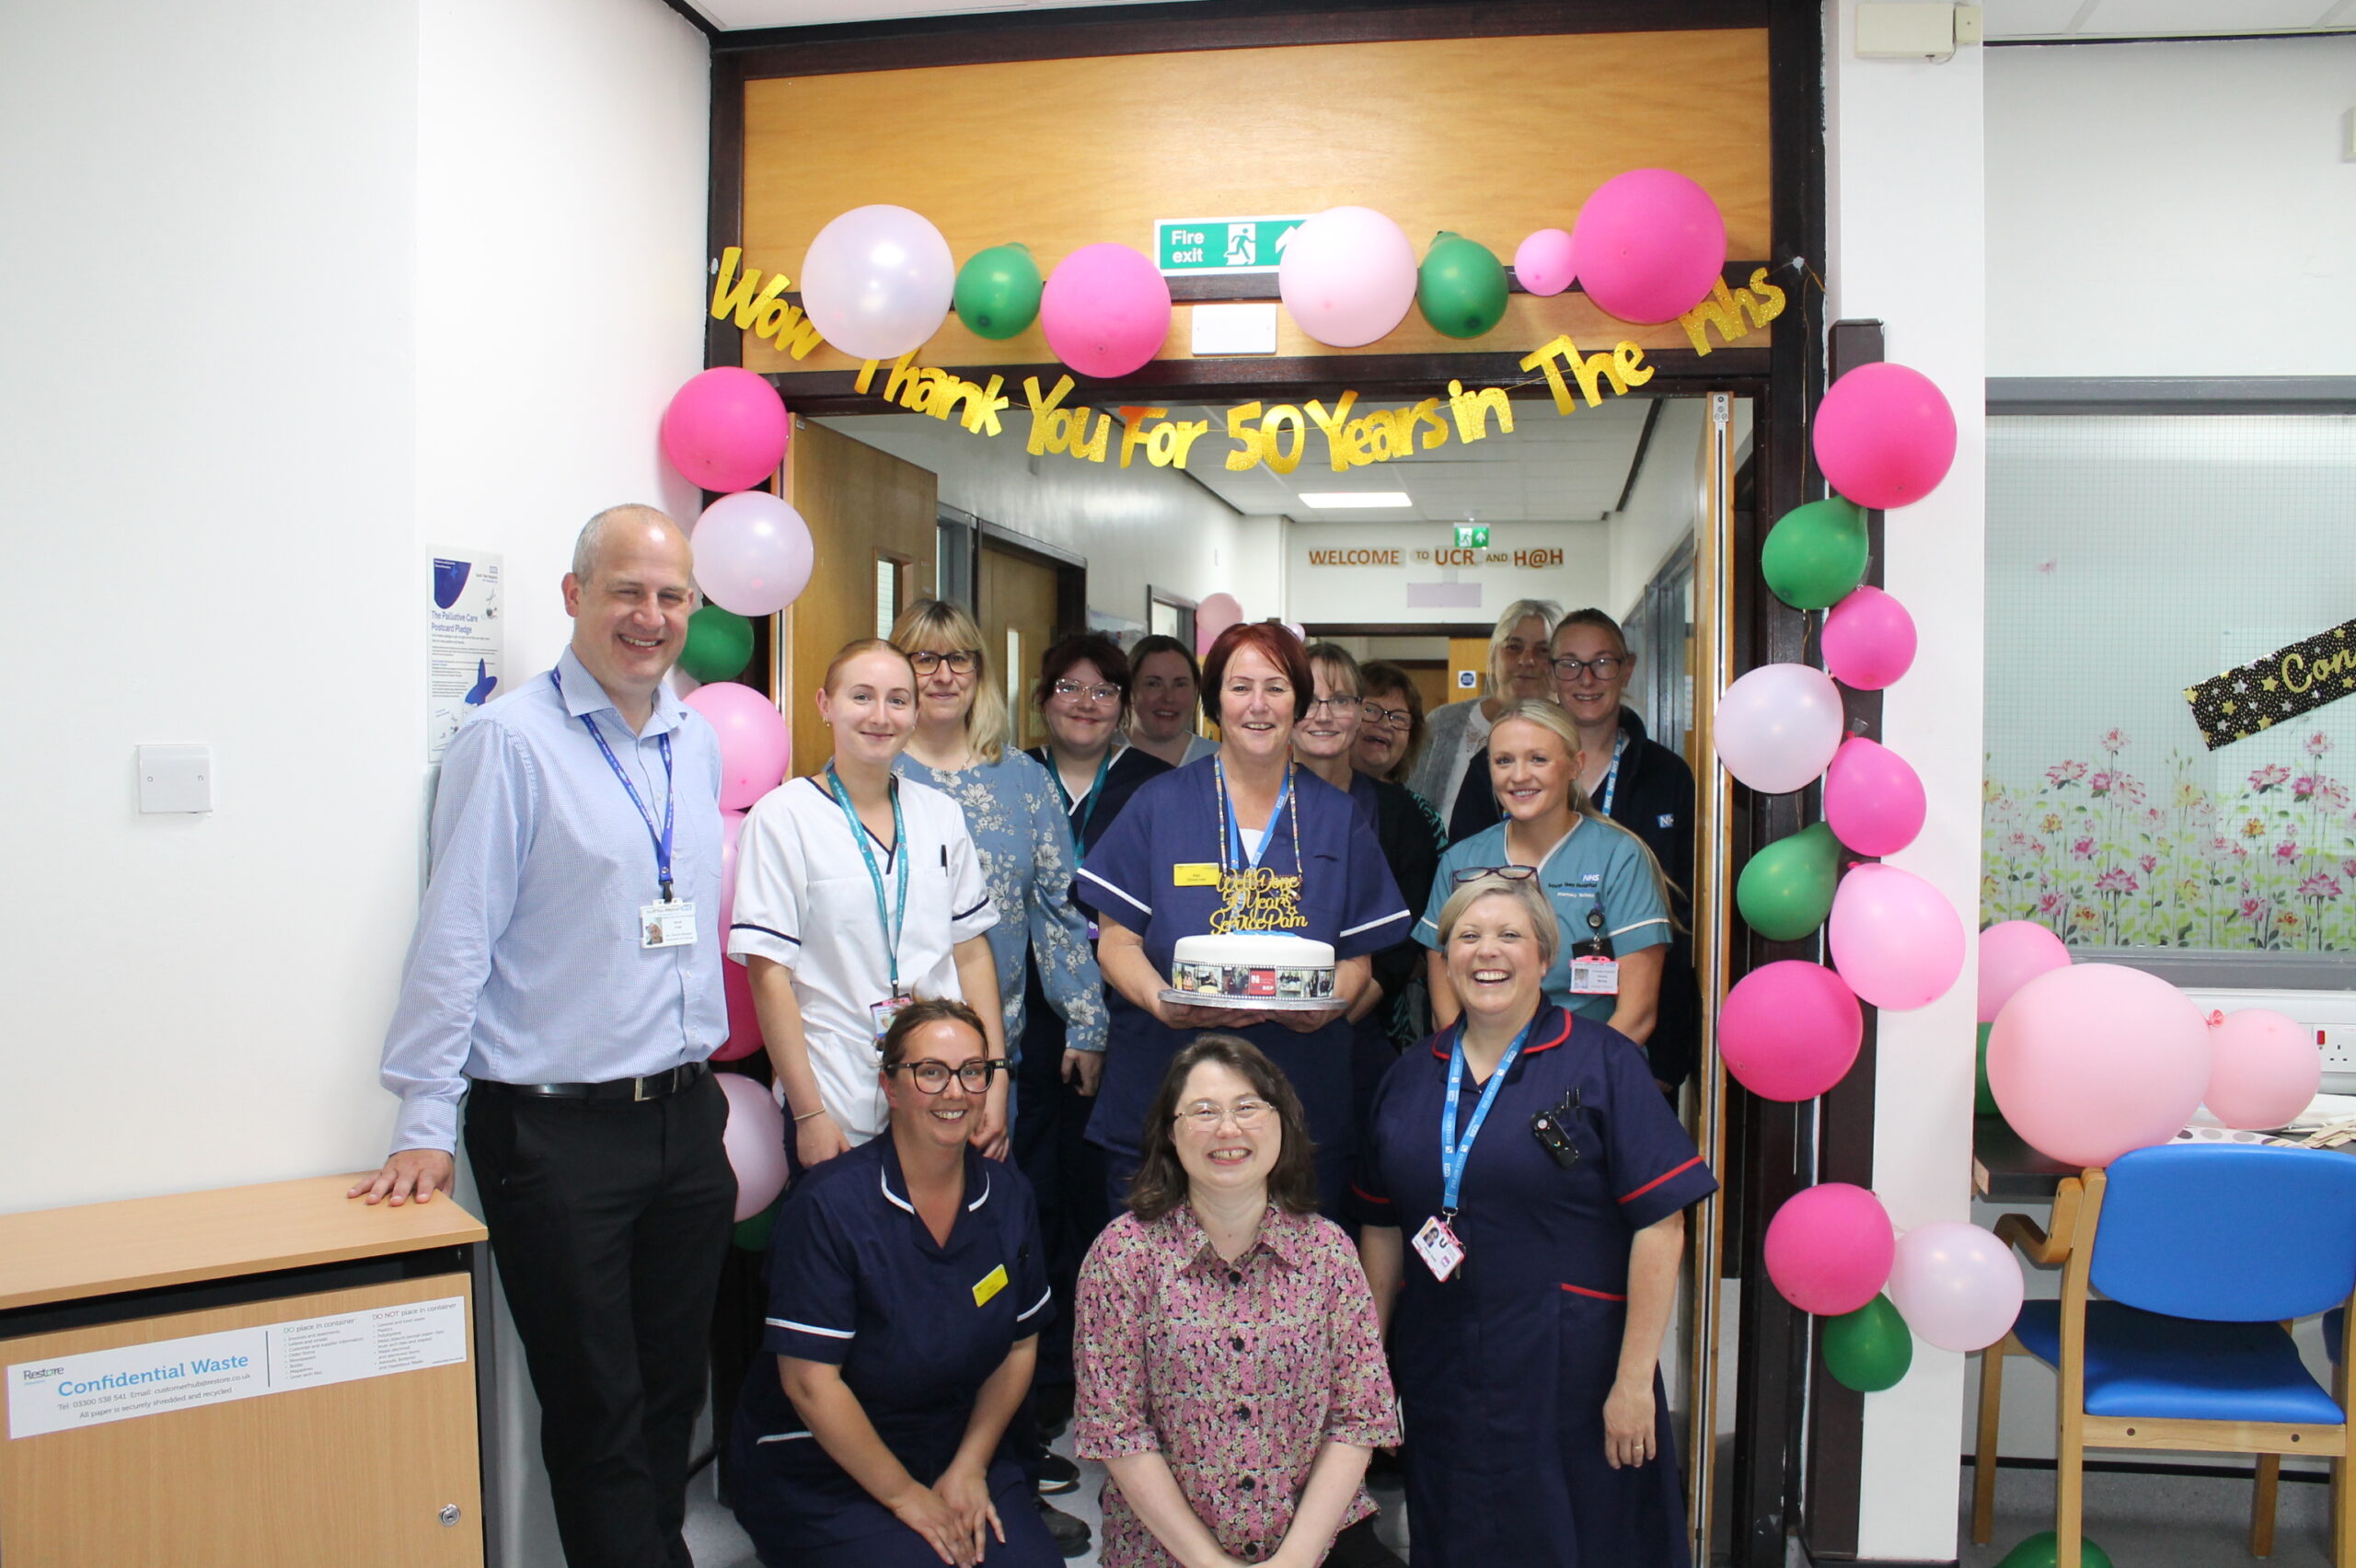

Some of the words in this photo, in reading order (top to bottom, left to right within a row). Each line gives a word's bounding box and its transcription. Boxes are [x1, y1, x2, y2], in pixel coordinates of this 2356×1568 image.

[1172, 230, 1205, 246] Fire
[1172, 248, 1203, 262] exit
[711, 247, 825, 361] Wow
[1022, 374, 1112, 463] You
[1119, 405, 1207, 469] For
[1225, 400, 1305, 475] 50
[1303, 389, 1449, 472] Years
[1448, 379, 1514, 444] in
[1519, 334, 1655, 415] The
[1309, 549, 1399, 565] WELCOME
[1416, 551, 1429, 560] TO
[1435, 548, 1475, 566] UCR
[1486, 553, 1507, 562] AND
[1514, 548, 1564, 568] H@H
[432, 610, 441, 619] The
[443, 611, 465, 622] Palliative
[466, 613, 478, 622] Care
[432, 622, 454, 632] Postcard
[456, 625, 472, 635] Pledge
[1217, 867, 1257, 892] Well
[1255, 867, 1300, 893] Done
[1246, 889, 1292, 913] Years
[1209, 908, 1266, 935] Service
[1263, 906, 1308, 930] Pam
[401, 1308, 418, 1317] place
[23, 1366, 64, 1380] Restore
[58, 1362, 186, 1397] Confidential
[191, 1355, 248, 1375] Waste
[113, 1393, 126, 1401] 541
[154, 1373, 251, 1394] customerhub@restore.co.uk
[91, 1409, 111, 1418] paper
[121, 1401, 151, 1412] securely
[153, 1394, 186, 1406] shredded
[188, 1391, 202, 1401] and
[202, 1387, 233, 1398] recycled
